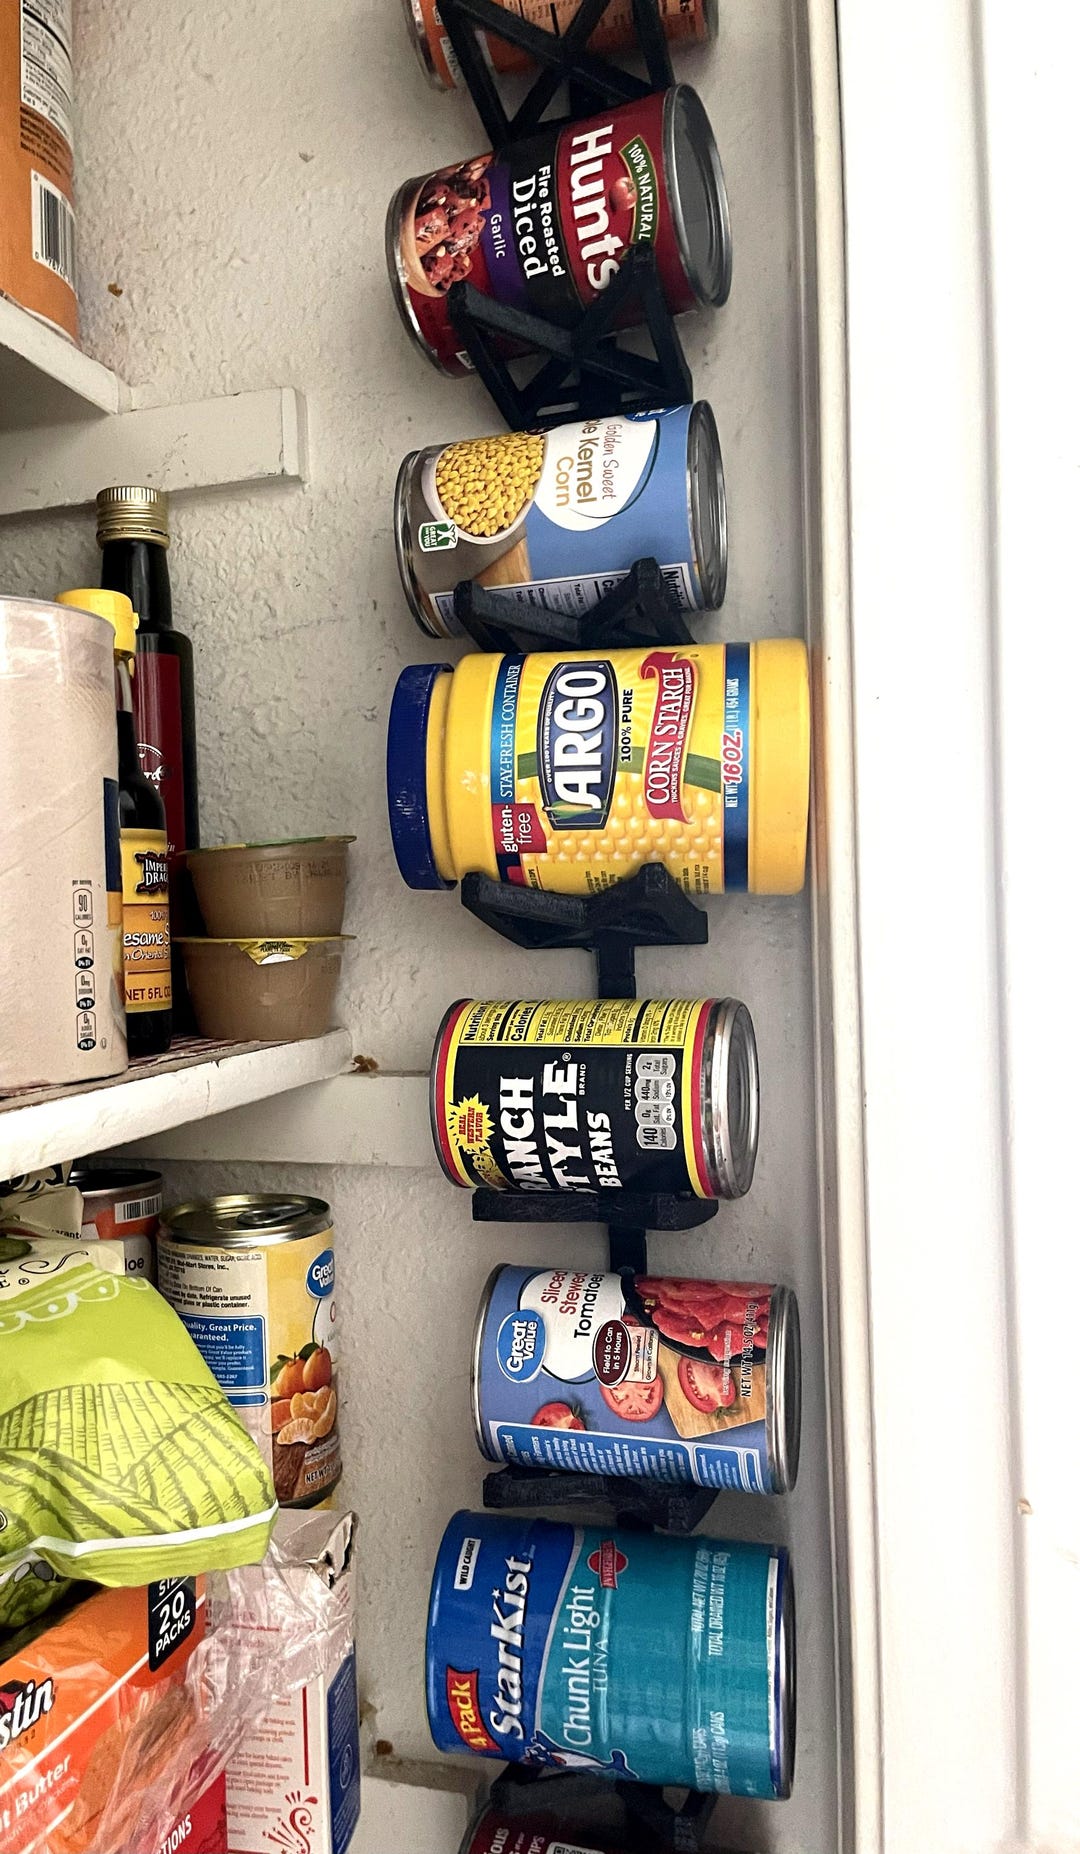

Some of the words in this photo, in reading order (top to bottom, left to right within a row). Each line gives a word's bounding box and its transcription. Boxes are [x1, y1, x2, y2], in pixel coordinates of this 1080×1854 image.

[538, 164, 551, 199] Fire
[638, 172, 653, 241] NATURAL
[490, 213, 507, 259] Garlic
[512, 175, 549, 280] Diced
[540, 201, 566, 277] Roasted
[602, 423, 623, 458] Golden
[555, 455, 574, 507] Corn
[576, 436, 600, 504] Kernel
[602, 458, 620, 501] Sweet
[501, 663, 521, 721] CONTAINER
[545, 690, 555, 718] QUALITY
[621, 689, 633, 723] PURE
[654, 668, 685, 736] STARCH
[554, 670, 607, 808] ARGO
[620, 727, 631, 763] 100%
[500, 723, 515, 798] STAY-FRESH
[646, 740, 675, 804] CORN
[723, 763, 741, 783] 16
[671, 773, 679, 803] THICKENS
[500, 804, 519, 853] gluten-
[516, 812, 533, 845] free
[79, 894, 88, 912] 90
[124, 932, 163, 948] esame
[147, 988, 153, 1000] 5
[154, 986, 163, 999] FL
[463, 1006, 487, 1041] Nutrition
[510, 1006, 534, 1042] Calories
[623, 1023, 633, 1043] Protein
[579, 1063, 587, 1096] BRAND
[624, 1053, 633, 1075] SERVING
[623, 1088, 632, 1098] 1/2
[624, 1075, 632, 1087] CUP
[624, 1099, 632, 1111] PER
[458, 1114, 466, 1136] REAL
[542, 1059, 598, 1194] TYLE
[642, 1127, 659, 1146] 140
[586, 1110, 623, 1188] BEANS
[197, 1262, 216, 1270] Stores,
[199, 1293, 229, 1302] Refrigerate
[202, 1300, 220, 1308] plastic
[208, 1323, 232, 1332] Great
[233, 1323, 257, 1331] Price.
[523, 1321, 538, 1361] Value
[605, 1326, 614, 1343] Can
[613, 1332, 623, 1354] Hours
[743, 1326, 755, 1337] OZ
[506, 1320, 528, 1374] Great
[604, 1344, 612, 1353] to
[742, 1338, 754, 1359] 14.5
[603, 1354, 611, 1374] Field
[741, 1360, 754, 1377] WT
[741, 1378, 753, 1398] NET
[463, 1539, 476, 1565] CAUGHT
[459, 1565, 470, 1585] WILD
[693, 1579, 707, 1593] WT
[710, 1582, 725, 1595] WT
[159, 1590, 185, 1635] 20
[692, 1592, 706, 1609] NET
[708, 1595, 724, 1631] DRAINED
[155, 1609, 191, 1657] PACKS
[562, 1585, 600, 1651] Light
[691, 1609, 705, 1633] TOTAL
[489, 1556, 532, 1740] StarKist
[708, 1631, 724, 1657] TOTAL
[592, 1639, 608, 1693] TUNA
[0, 1679, 52, 1750] stin
[451, 1680, 482, 1734] Pack
[562, 1656, 592, 1746] Chunk
[710, 1711, 725, 1736] CANS
[469, 1738, 489, 1747] 4
[15, 1754, 71, 1817] Butter
